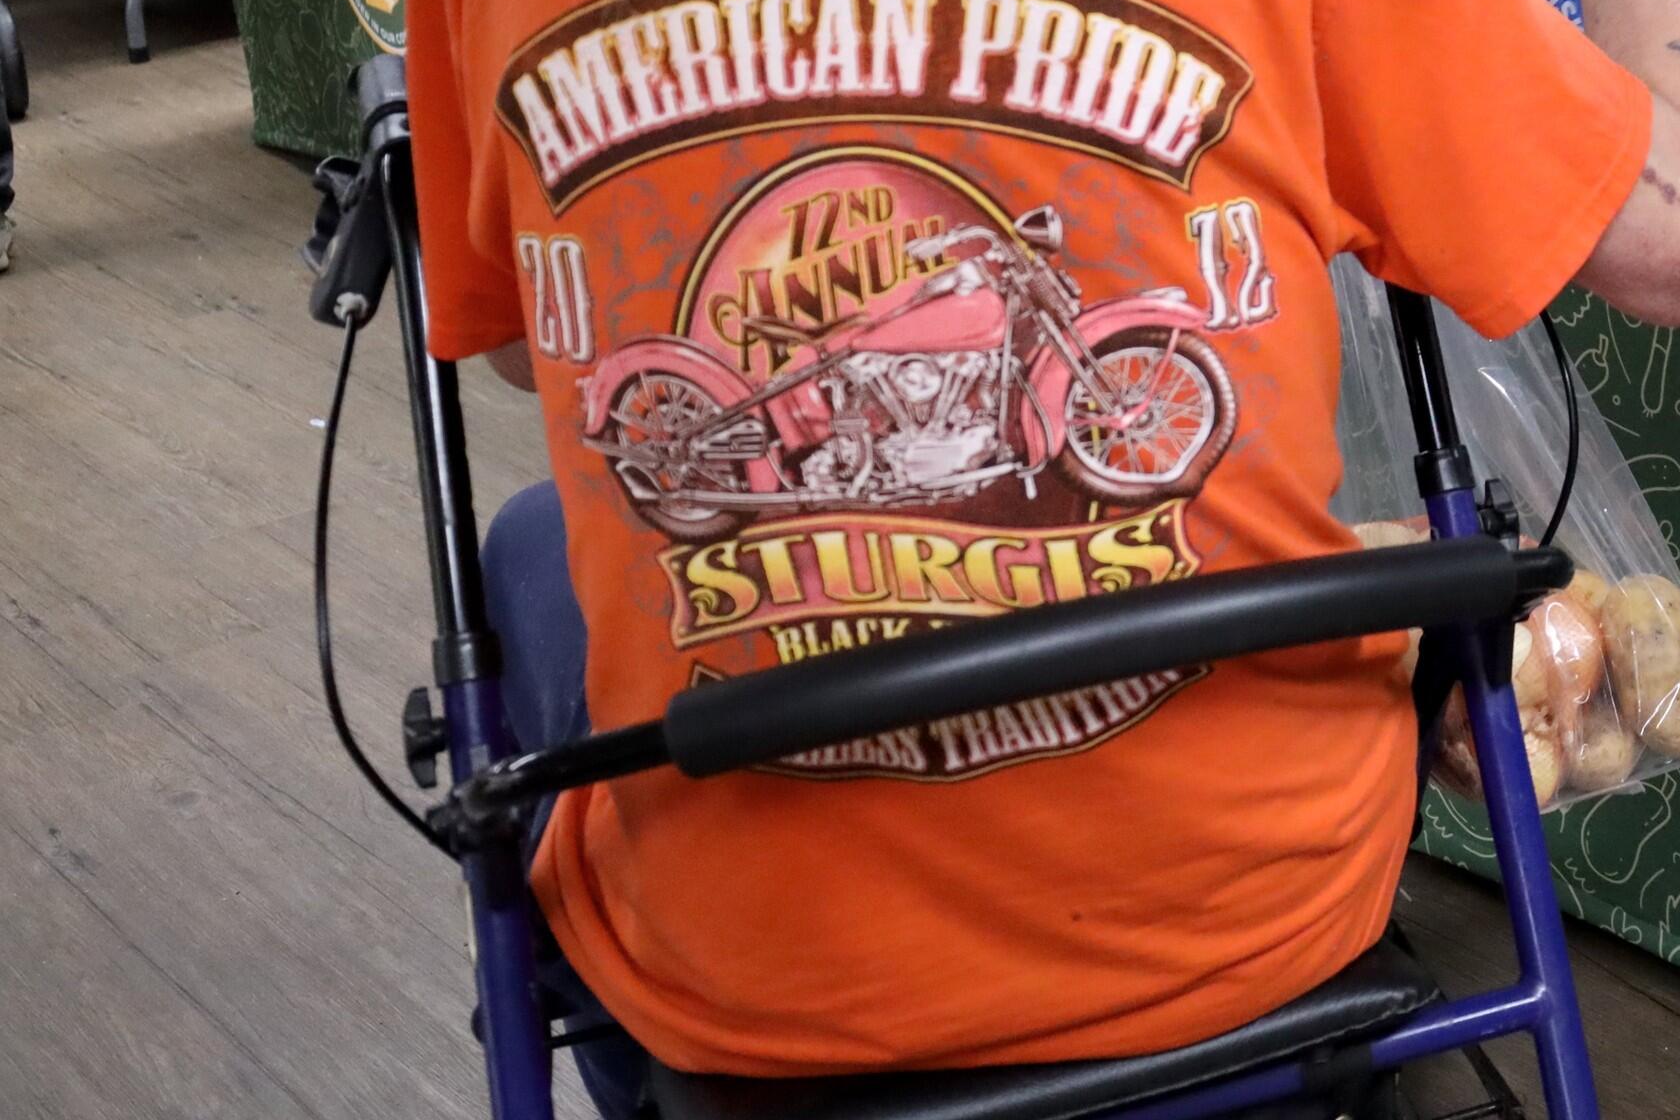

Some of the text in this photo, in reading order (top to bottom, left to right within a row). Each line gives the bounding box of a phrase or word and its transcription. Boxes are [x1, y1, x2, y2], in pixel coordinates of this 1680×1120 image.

[781, 184, 896, 261] 72ND
[1185, 197, 1279, 333] 12
[517, 233, 595, 363] 20
[706, 214, 960, 377] ANNUAL
[686, 516, 1176, 627] STURGIS
